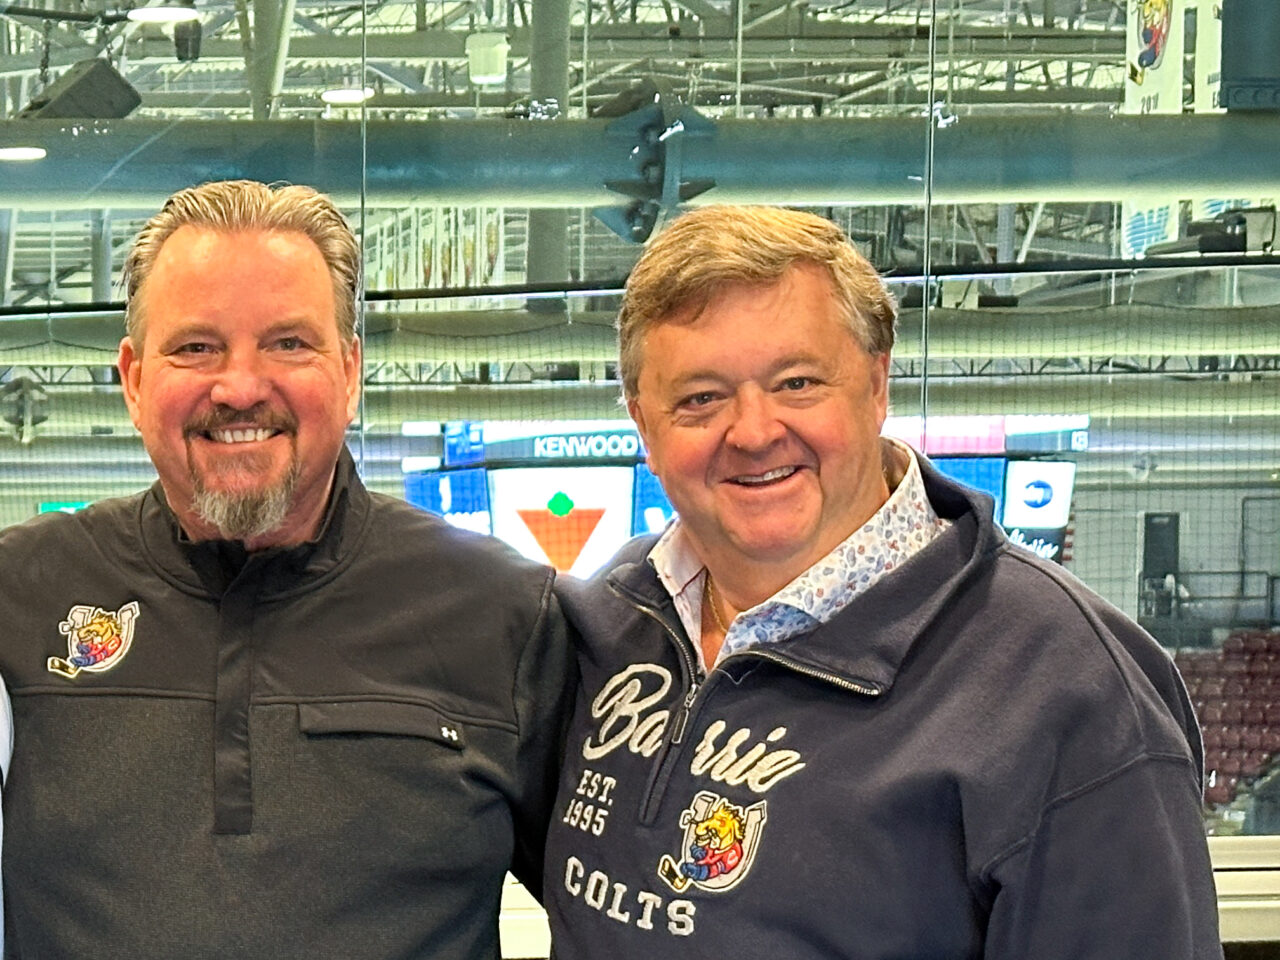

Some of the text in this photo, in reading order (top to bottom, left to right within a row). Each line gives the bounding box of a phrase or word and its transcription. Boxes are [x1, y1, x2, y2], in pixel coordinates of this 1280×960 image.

[534, 435, 639, 458] KENWOOD
[583, 663, 806, 793] Barrie
[576, 769, 617, 806] EST.
[563, 798, 609, 837] 1995
[564, 856, 697, 937] COLTS
